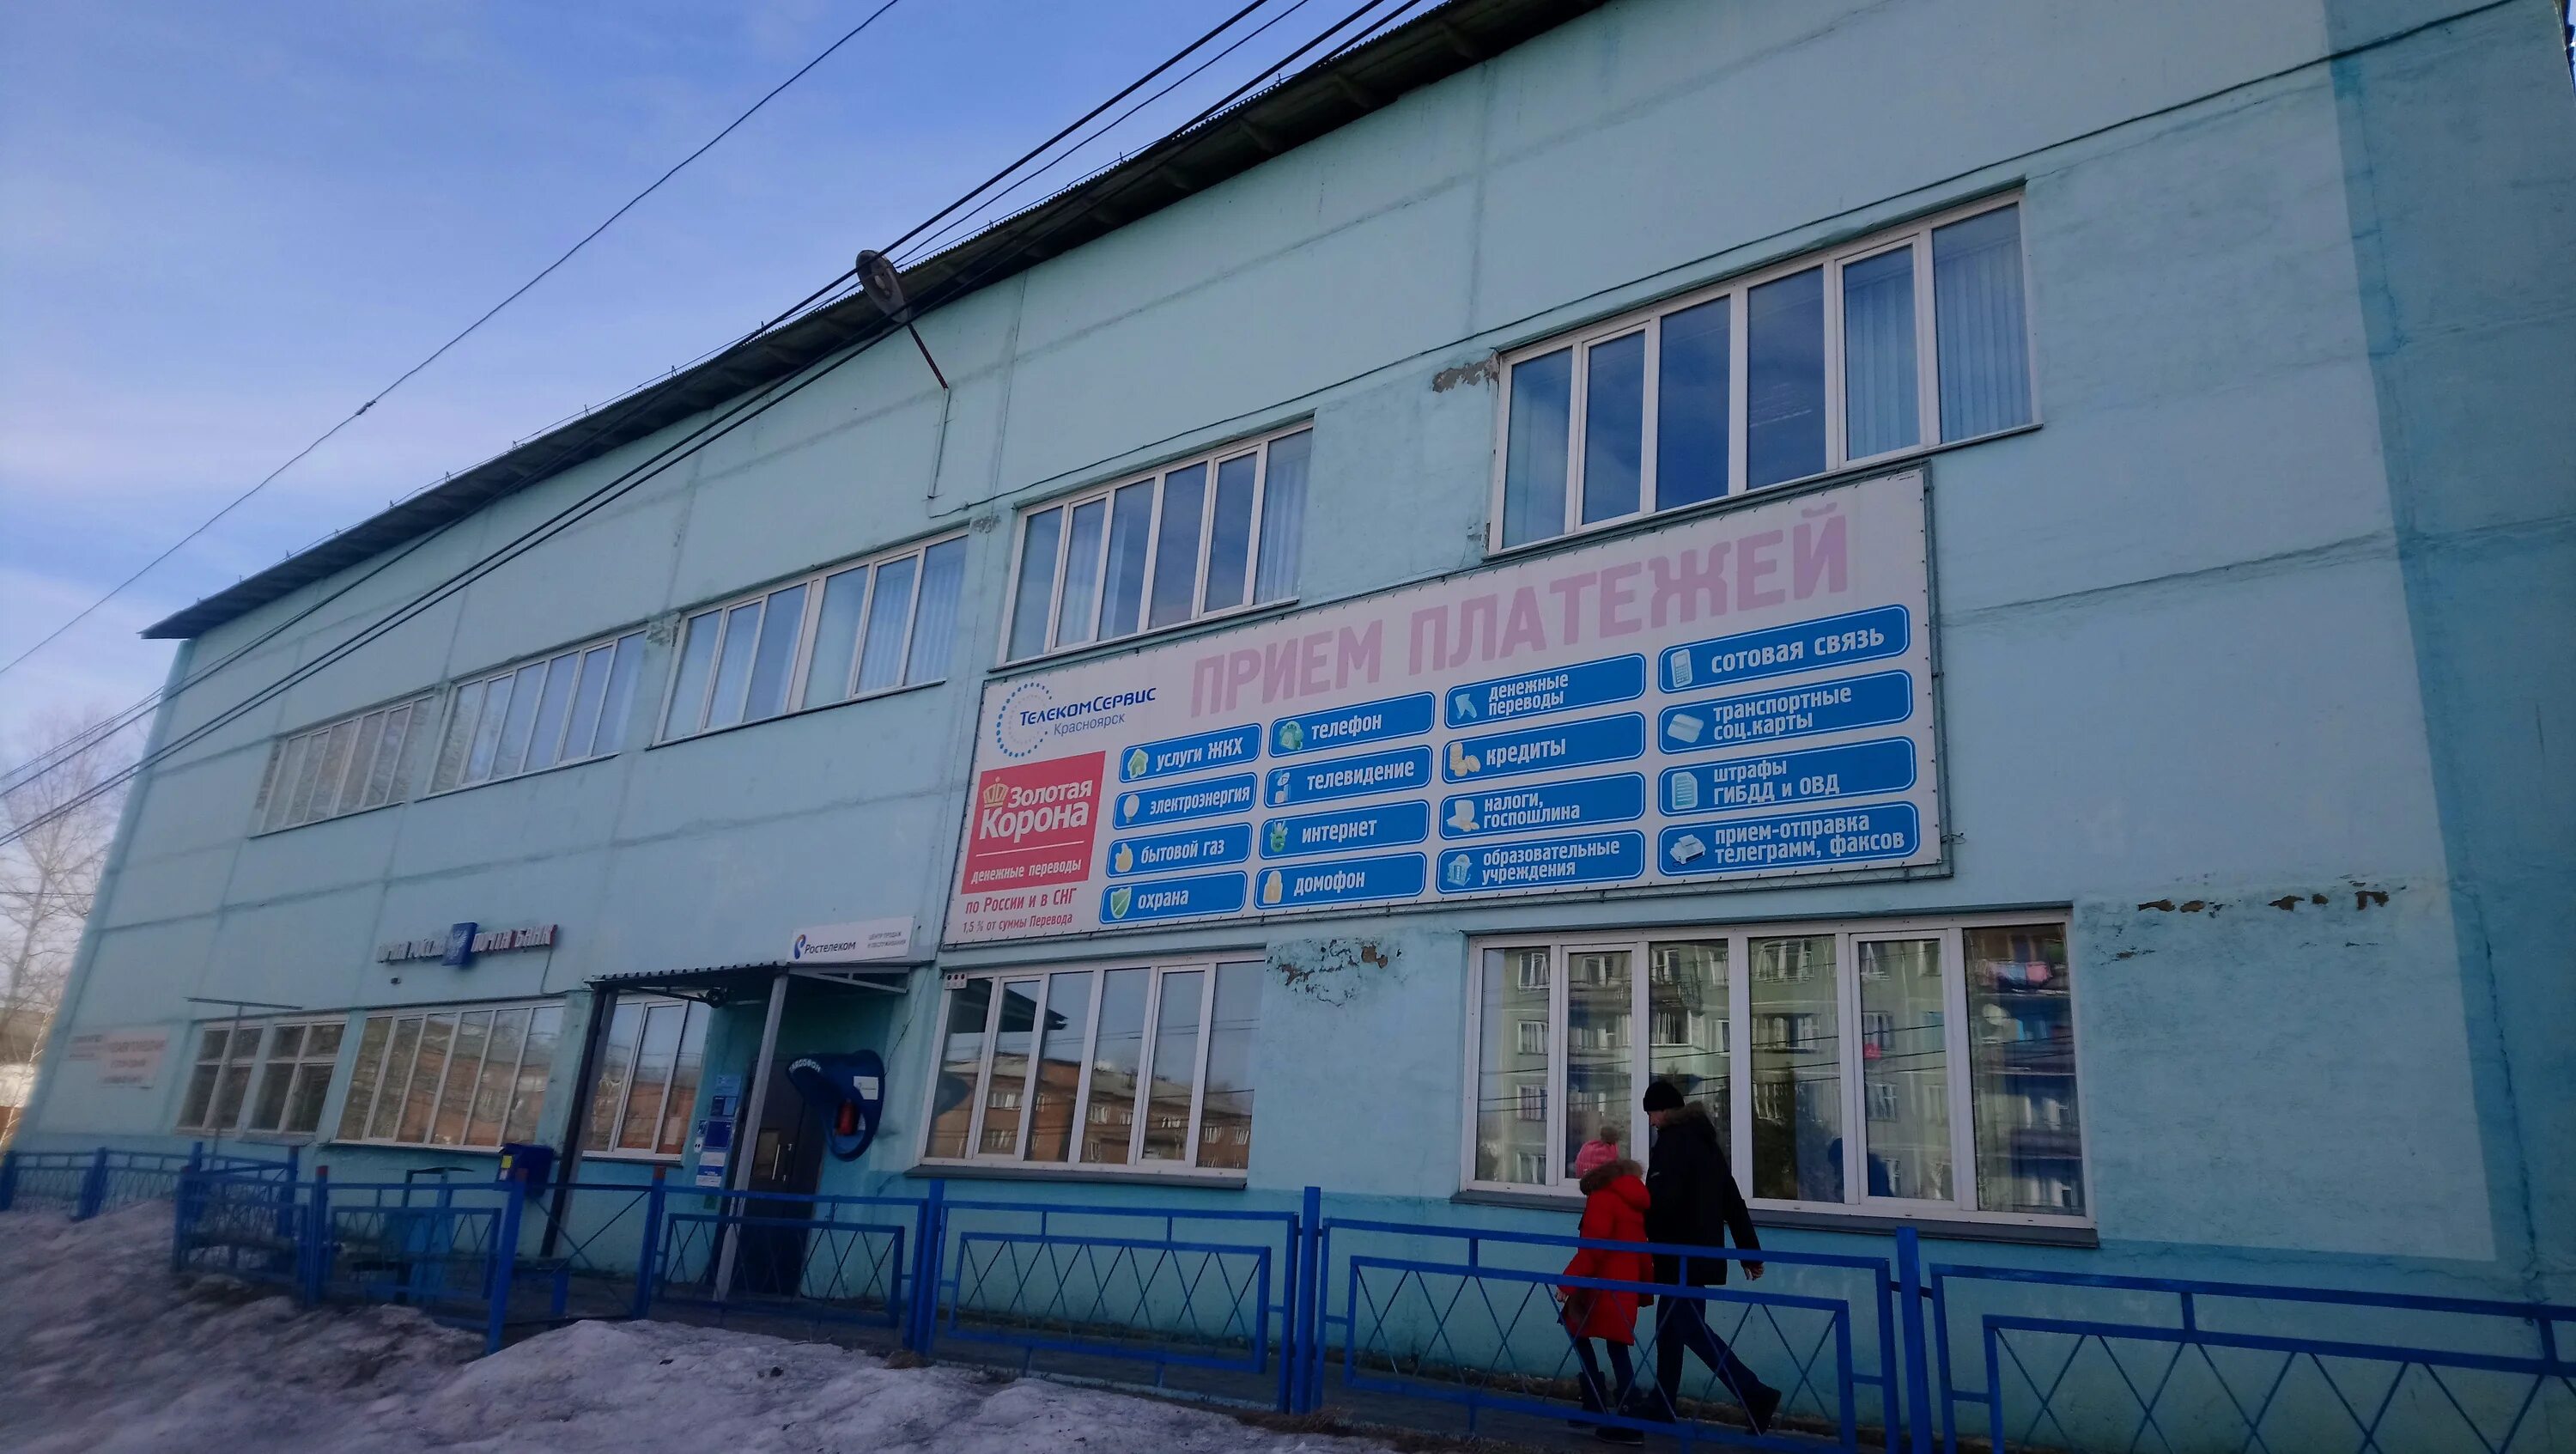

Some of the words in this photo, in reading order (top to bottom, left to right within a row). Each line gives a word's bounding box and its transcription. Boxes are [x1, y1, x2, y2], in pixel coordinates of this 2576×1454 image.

[1190, 616, 1382, 718] ПРИЕМ
[1408, 502, 1850, 674] ПЛАТЕЖЕЙ
[1711, 641, 1803, 673] сотовая
[1814, 628, 1885, 656] связь
[1489, 674, 1569, 702] денежные
[1489, 691, 1564, 716] переводы
[1713, 687, 1851, 723] транспортные
[1054, 713, 1126, 737] Красноярск
[1311, 714, 1382, 740] телефон
[1714, 712, 1813, 740] соц.карты
[1156, 747, 1202, 771] услуги
[1207, 737, 1243, 760] ЖКХ
[1486, 739, 1566, 767] кредиты
[1307, 761, 1415, 791] телевидение
[1714, 760, 1787, 782] штрафы
[1007, 780, 1093, 809] Золотая
[1150, 786, 1250, 815] электроэнергия
[1484, 793, 1543, 812] налоги,
[1714, 782, 1775, 805] ГИБДД
[1782, 782, 1792, 797] и
[1800, 774, 1840, 795] ОВД
[979, 800, 1090, 843] Корона
[1484, 805, 1580, 829] госпошлина
[1716, 815, 1869, 845] прием-отправка
[1302, 820, 1377, 843] интернет
[1140, 840, 1198, 864] бытовой
[1203, 839, 1224, 855] газ
[1483, 840, 1620, 866] образовательные
[1715, 839, 1821, 864] телеграмм,
[1830, 832, 1905, 856] факсов
[970, 865, 1024, 884] денежные
[1029, 859, 1081, 879] переводы
[1294, 870, 1365, 896] домофон
[1482, 861, 1576, 885] учреждения
[965, 901, 979, 914] по
[983, 897, 1024, 913] России
[1029, 895, 1036, 908] и
[1053, 887, 1077, 906] СНГ
[1138, 890, 1189, 910] охрана
[963, 921, 975, 934] 1,5
[987, 921, 997, 931] от
[999, 917, 1027, 933] суммы
[1030, 913, 1072, 928] Перевода
[805, 941, 856, 954] Ростелеком
